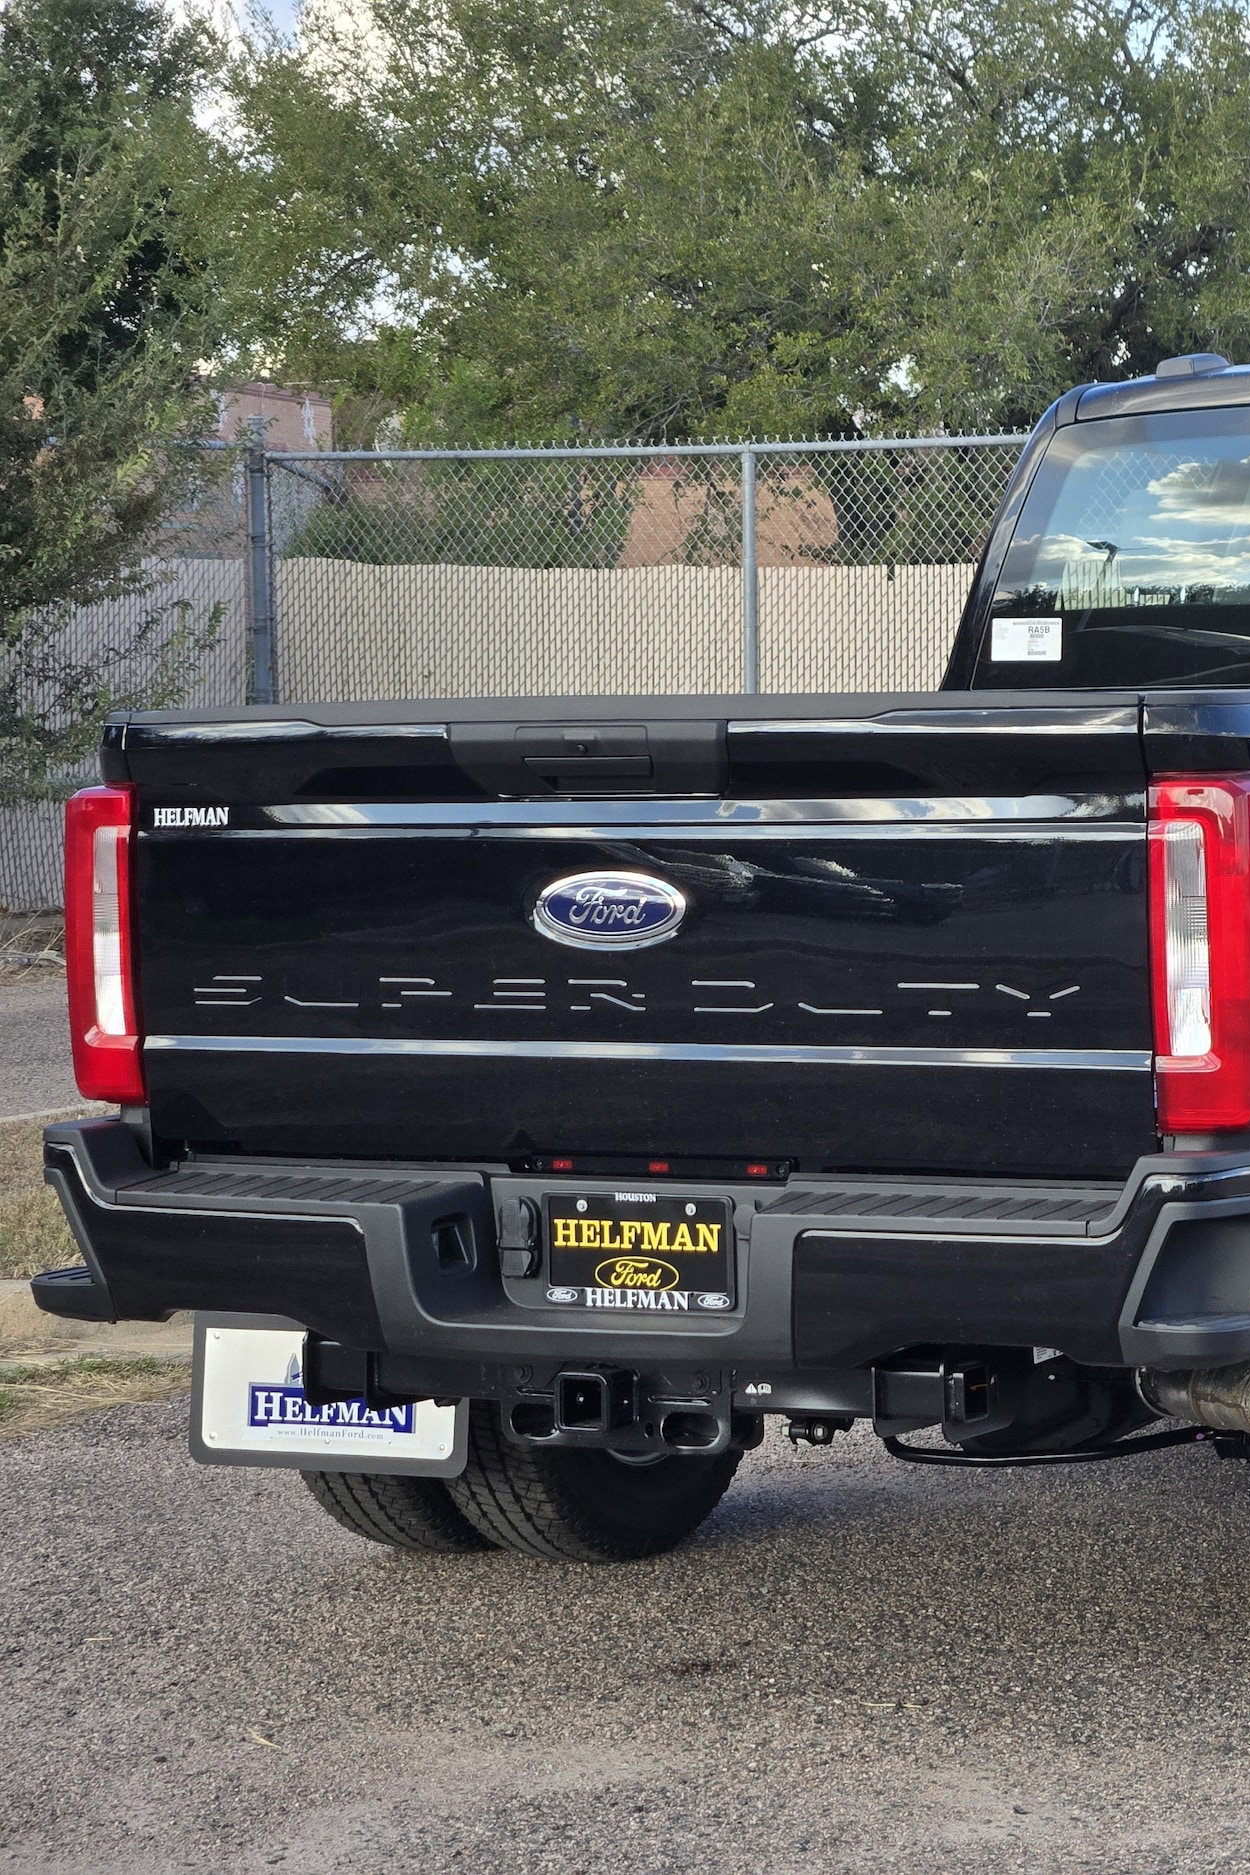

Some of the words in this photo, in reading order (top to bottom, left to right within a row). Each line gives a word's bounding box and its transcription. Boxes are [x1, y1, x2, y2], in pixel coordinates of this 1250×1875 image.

[153, 807, 229, 827] HELFMAN
[569, 886, 648, 925] Ford
[193, 974, 647, 1011] SUPER
[691, 979, 1081, 1018] DUTY
[614, 1192, 658, 1203] HOUSTON
[553, 1218, 722, 1253] HELFMAN
[610, 1260, 663, 1287] Ford
[585, 1287, 690, 1311] HELFMAN
[254, 1391, 408, 1426] HELFMAN
[277, 1427, 384, 1441] www.HelfmanFord.com
